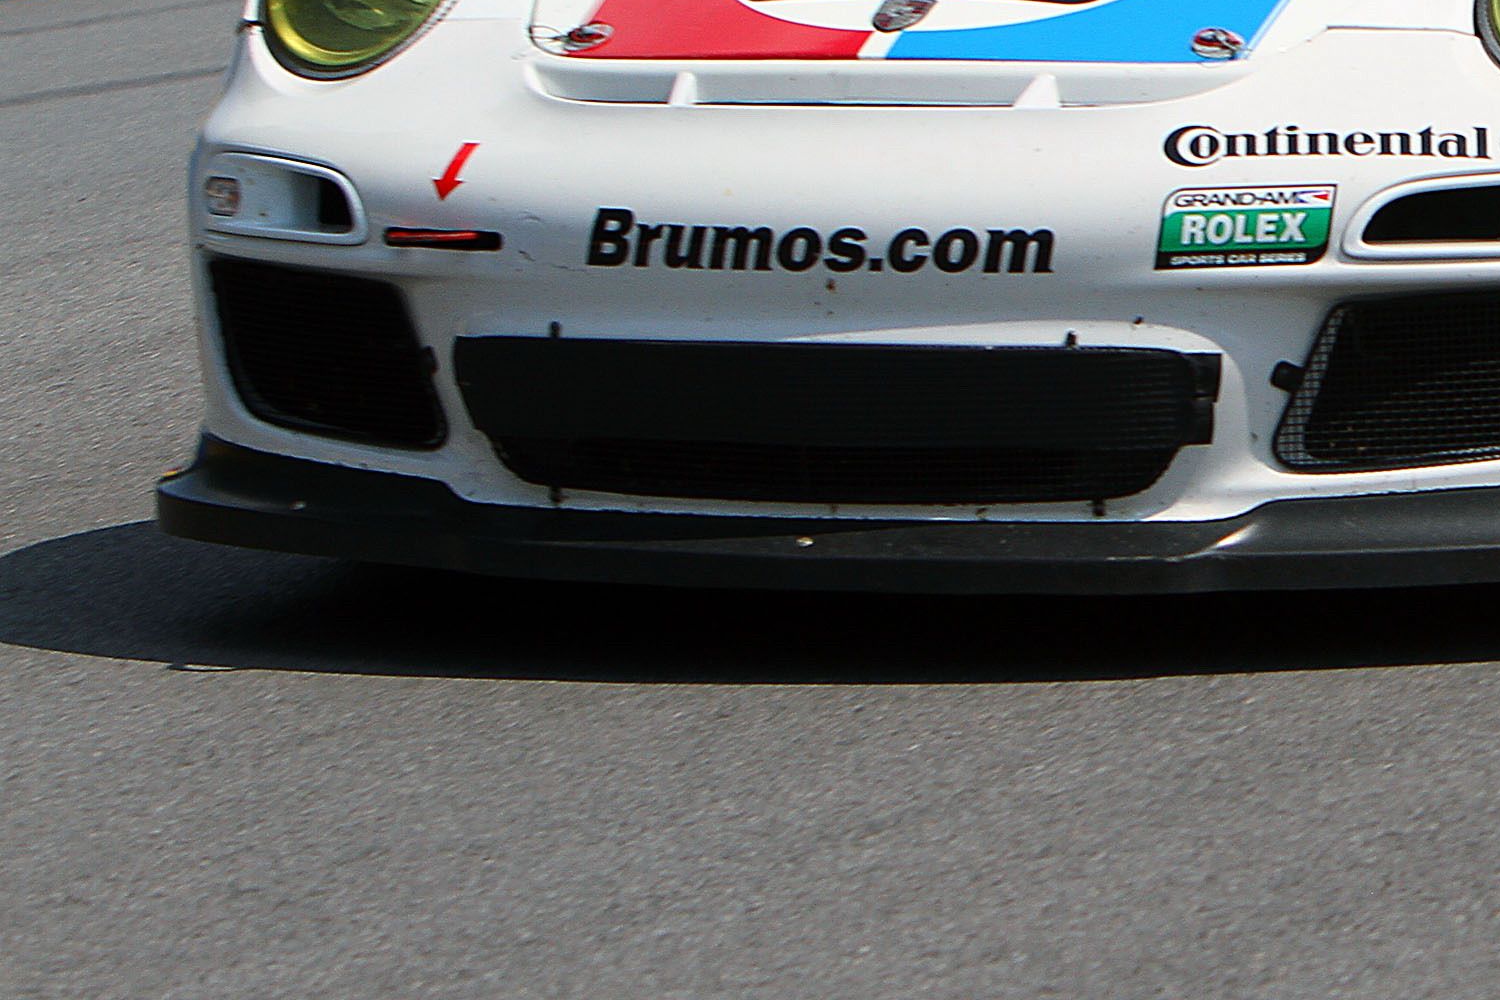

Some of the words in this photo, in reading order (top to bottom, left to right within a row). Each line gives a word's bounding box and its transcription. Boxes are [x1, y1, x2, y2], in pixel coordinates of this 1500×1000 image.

[1164, 125, 1492, 168] Continental
[1175, 191, 1299, 208] GRAND-AM
[585, 207, 1055, 274] Brumos.com
[1180, 212, 1308, 246] ROLEX
[1226, 254, 1257, 265] CAR
